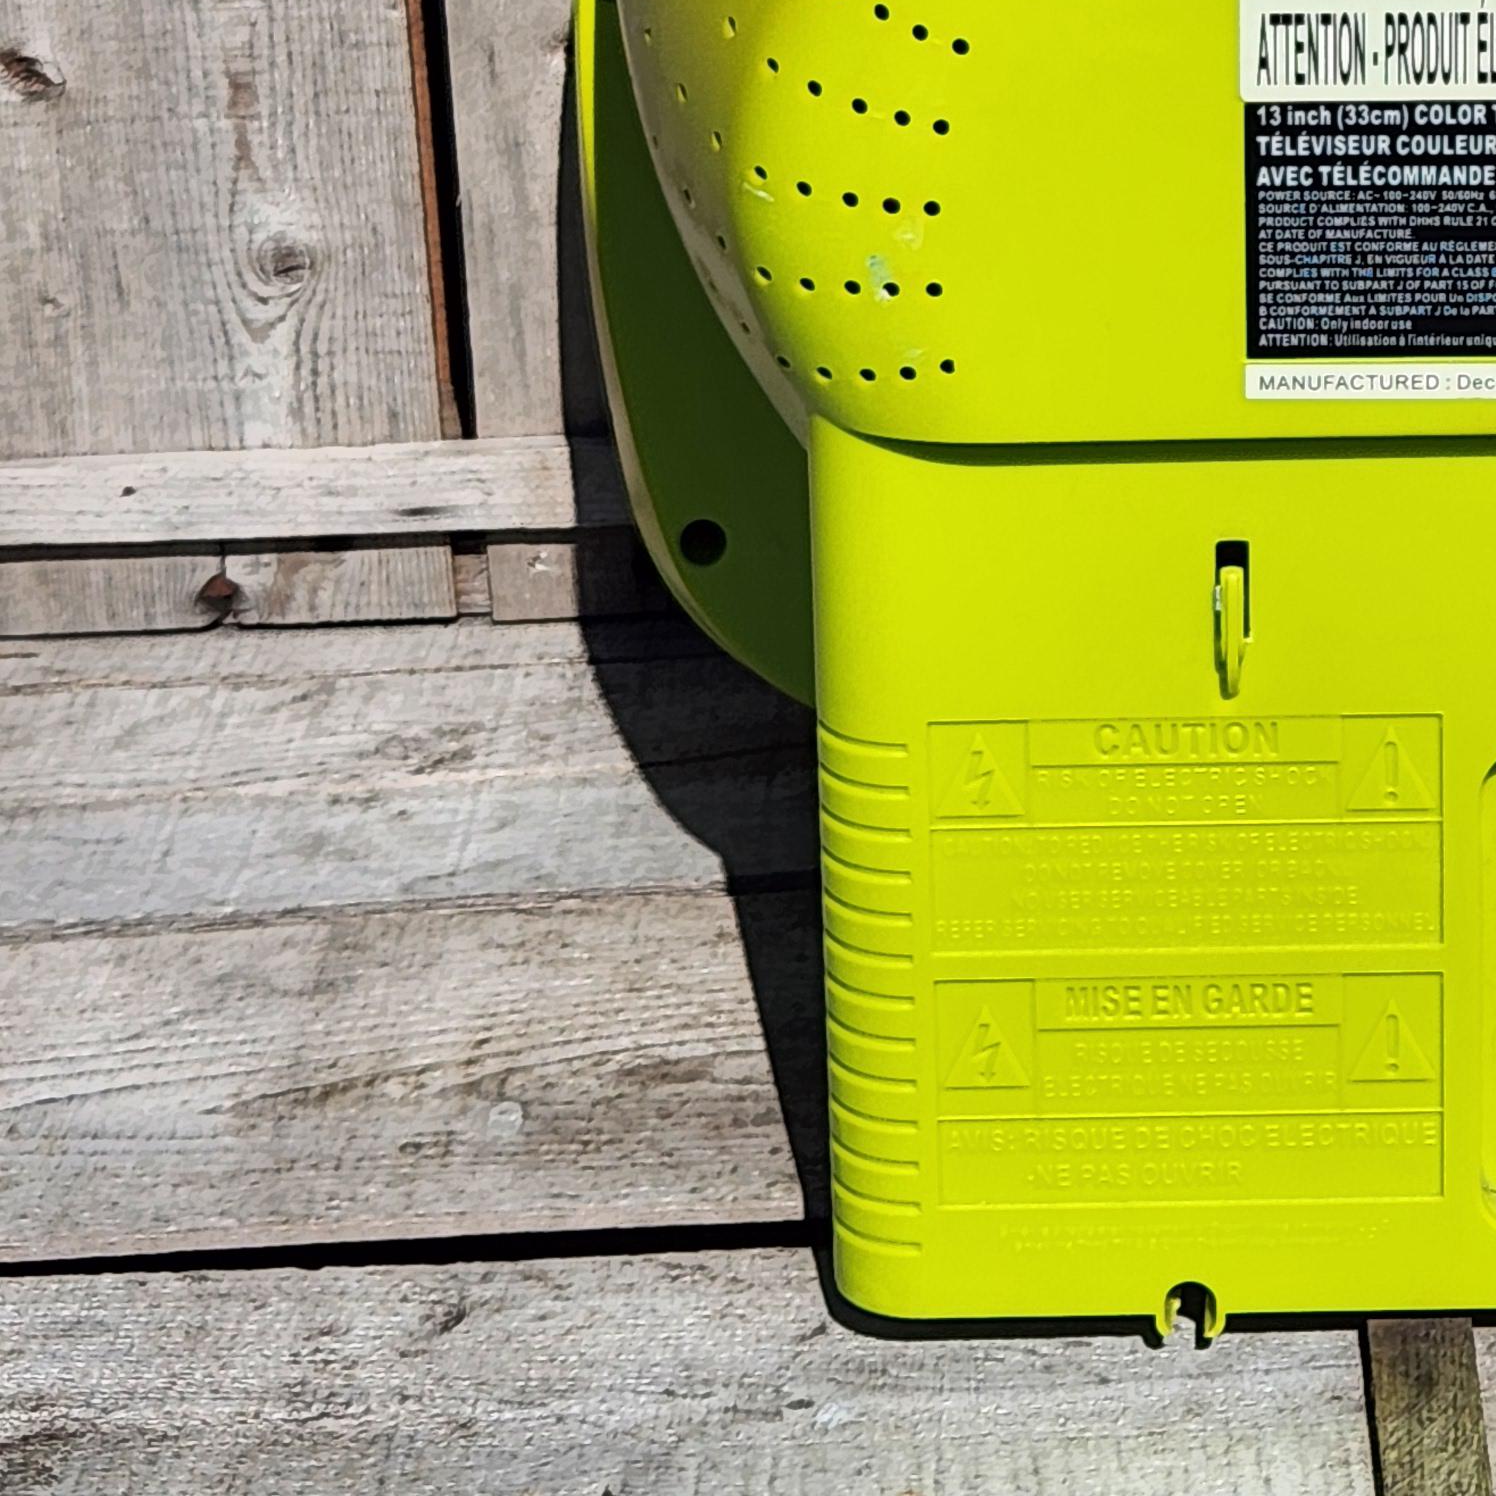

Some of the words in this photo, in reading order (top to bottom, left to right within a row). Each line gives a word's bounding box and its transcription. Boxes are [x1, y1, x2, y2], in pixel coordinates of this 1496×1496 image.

[1256, 11, 1366, 85] ATTENTION
[1384, 11, 1470, 85] PRODUIT
[1256, 105, 1282, 126] 13
[1286, 105, 1331, 126] inch
[1337, 104, 1409, 131] (33cm)
[1414, 104, 1487, 125] COLOR
[1256, 131, 1391, 156] TÉLÉVISEUR
[1256, 165, 1313, 186] AVEC
[1318, 161, 1496, 186] TÉLÉCOMMANDE
[1258, 229, 1274, 239] AT
[1275, 229, 1305, 239] DATE
[1308, 229, 1323, 239] OF
[1259, 267, 1318, 278] COMPLIES
[1320, 267, 1349, 278] WITH
[1352, 267, 1373, 278] THE
[1376, 267, 1414, 278] LIMITS
[1416, 267, 1440, 278] FOR
[1441, 267, 1450, 278] A
[1452, 267, 1489, 278] CLASS
[1259, 280, 1321, 291] PURSUANT
[1324, 280, 1339, 291] TO
[1342, 280, 1395, 291] SUBPART
[1397, 280, 1404, 291] J
[1406, 280, 1421, 291] OF
[1424, 280, 1453, 291] PART
[1456, 280, 1469, 291] 15
[1471, 280, 1486, 291] OF
[1259, 318, 1318, 329] CAUTION:
[1320, 318, 1349, 332] Only
[1350, 318, 1389, 329] indoor
[1391, 320, 1412, 329] use
[1259, 334, 1333, 346] ATTENTION:
[1334, 334, 1397, 346] Utilisation
[1399, 334, 1406, 346] à
[1259, 374, 1440, 391] MANUFACTURED
[1093, 721, 1280, 760] CAUTION
[1065, 983, 1142, 1021] MISE
[1151, 983, 1192, 1021] EN
[1203, 982, 1314, 1020] GARDE
